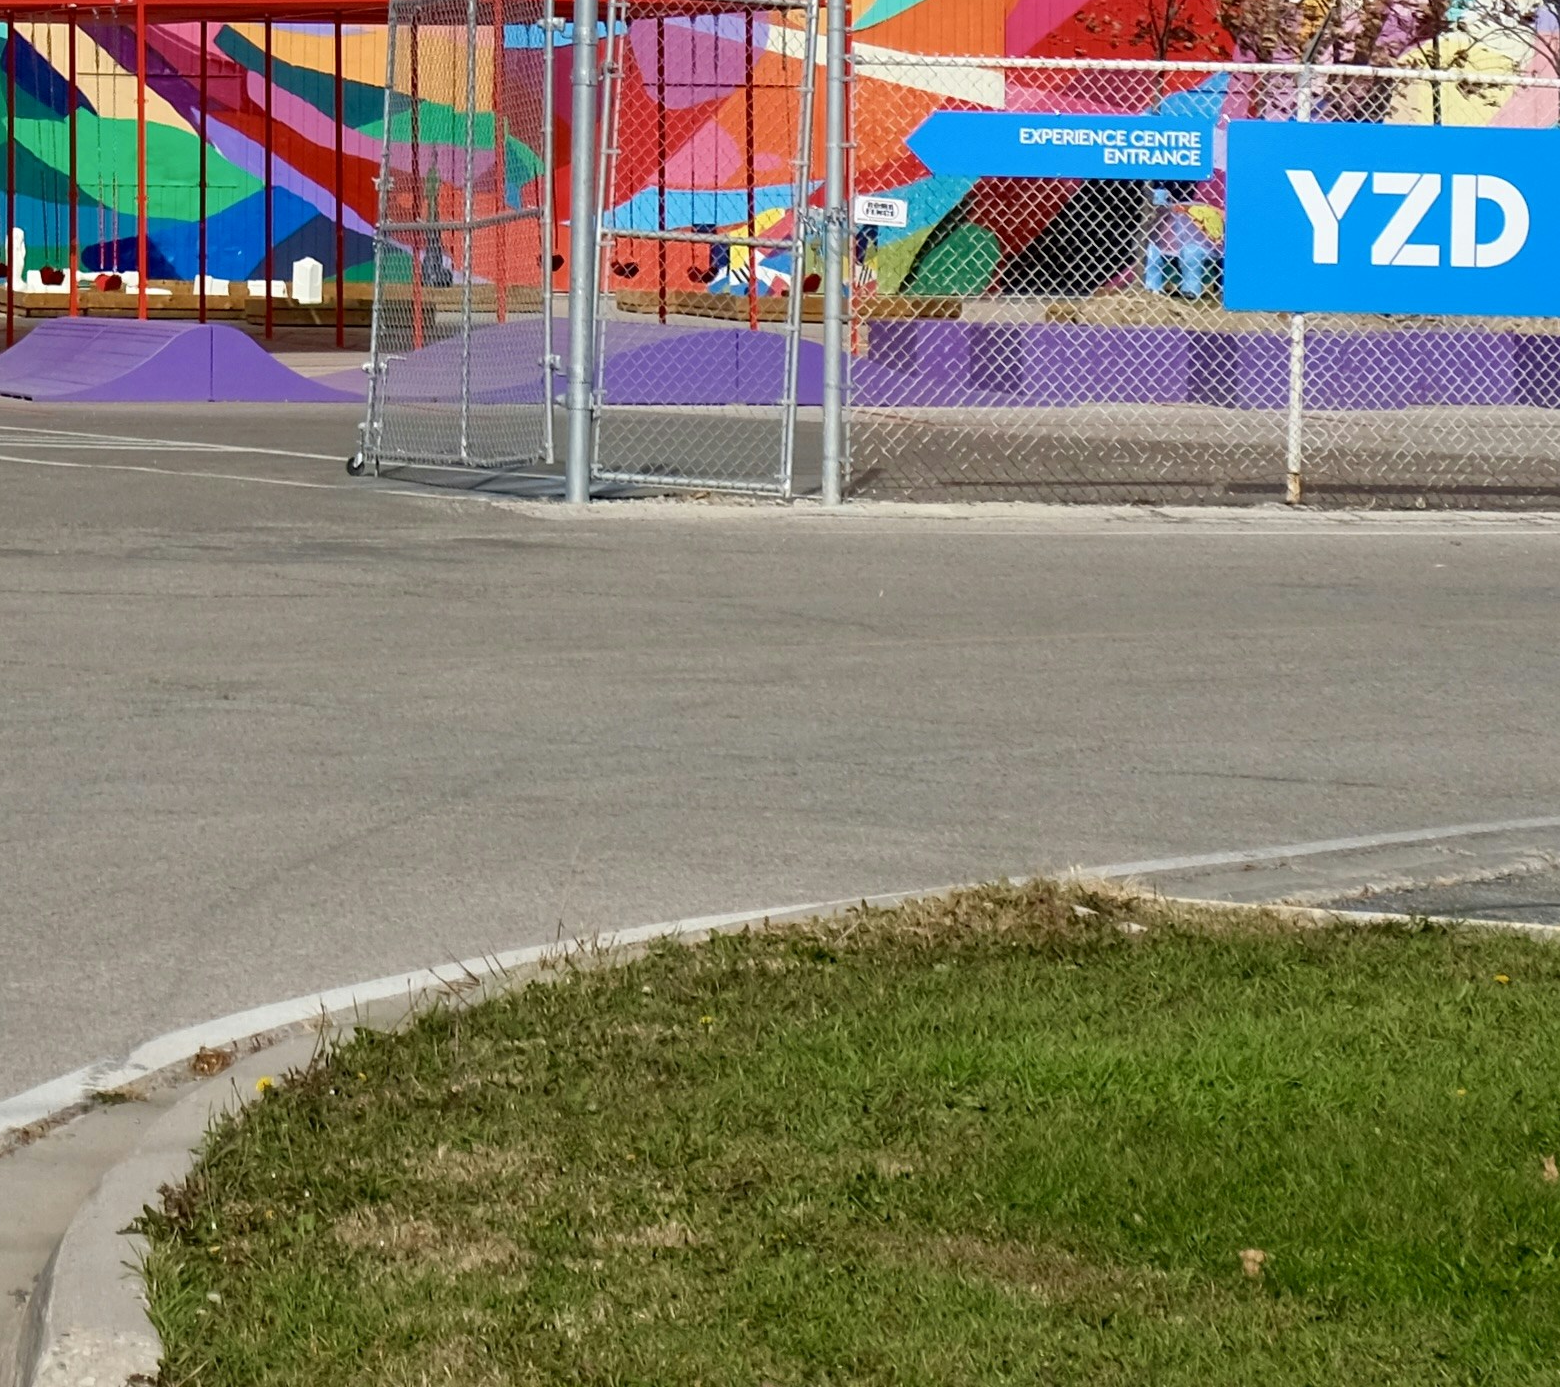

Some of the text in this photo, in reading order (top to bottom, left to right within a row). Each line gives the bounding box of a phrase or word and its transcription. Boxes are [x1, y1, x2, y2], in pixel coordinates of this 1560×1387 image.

[1019, 128, 1202, 148] EXPERIENCE CENTRE
[1103, 148, 1202, 167] ENTRANCE
[1284, 169, 1530, 268] YZD
